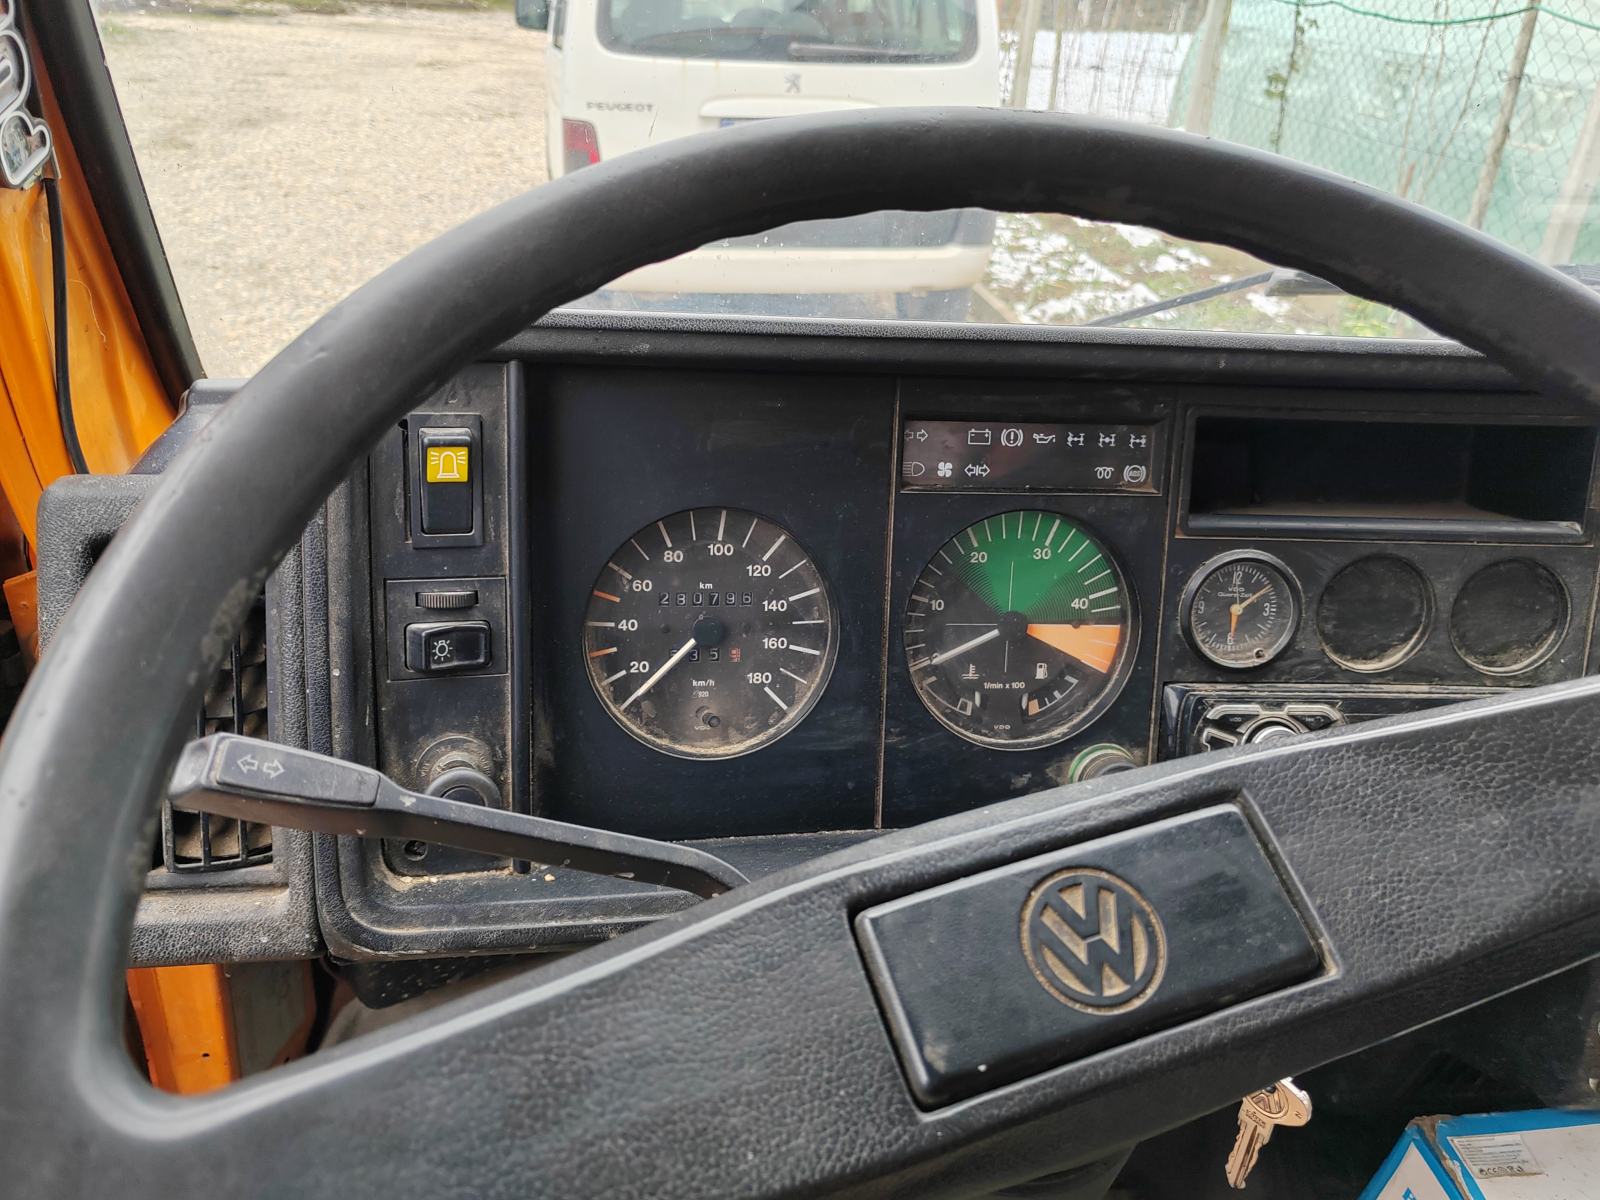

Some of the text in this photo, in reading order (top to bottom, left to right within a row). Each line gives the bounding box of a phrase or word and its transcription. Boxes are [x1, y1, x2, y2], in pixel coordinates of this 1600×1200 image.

[586, 102, 655, 112] PEUGEOT
[707, 544, 734, 556] 100
[1033, 548, 1052, 560] 30
[663, 551, 684, 563] 80
[970, 552, 988, 564] 20
[746, 565, 772, 577] 120
[632, 580, 653, 592] 60
[762, 600, 788, 612] 140
[930, 599, 945, 611] 10
[1071, 598, 1089, 610] 40
[1198, 601, 1205, 614] 9
[1262, 602, 1270, 617] 3
[617, 619, 638, 631] 40
[762, 637, 788, 649] 160
[629, 661, 650, 673] 20
[692, 679, 715, 687] km/h
[747, 672, 772, 684] 180
[984, 681, 1003, 689] 1/min
[1011, 681, 1026, 689] 100
